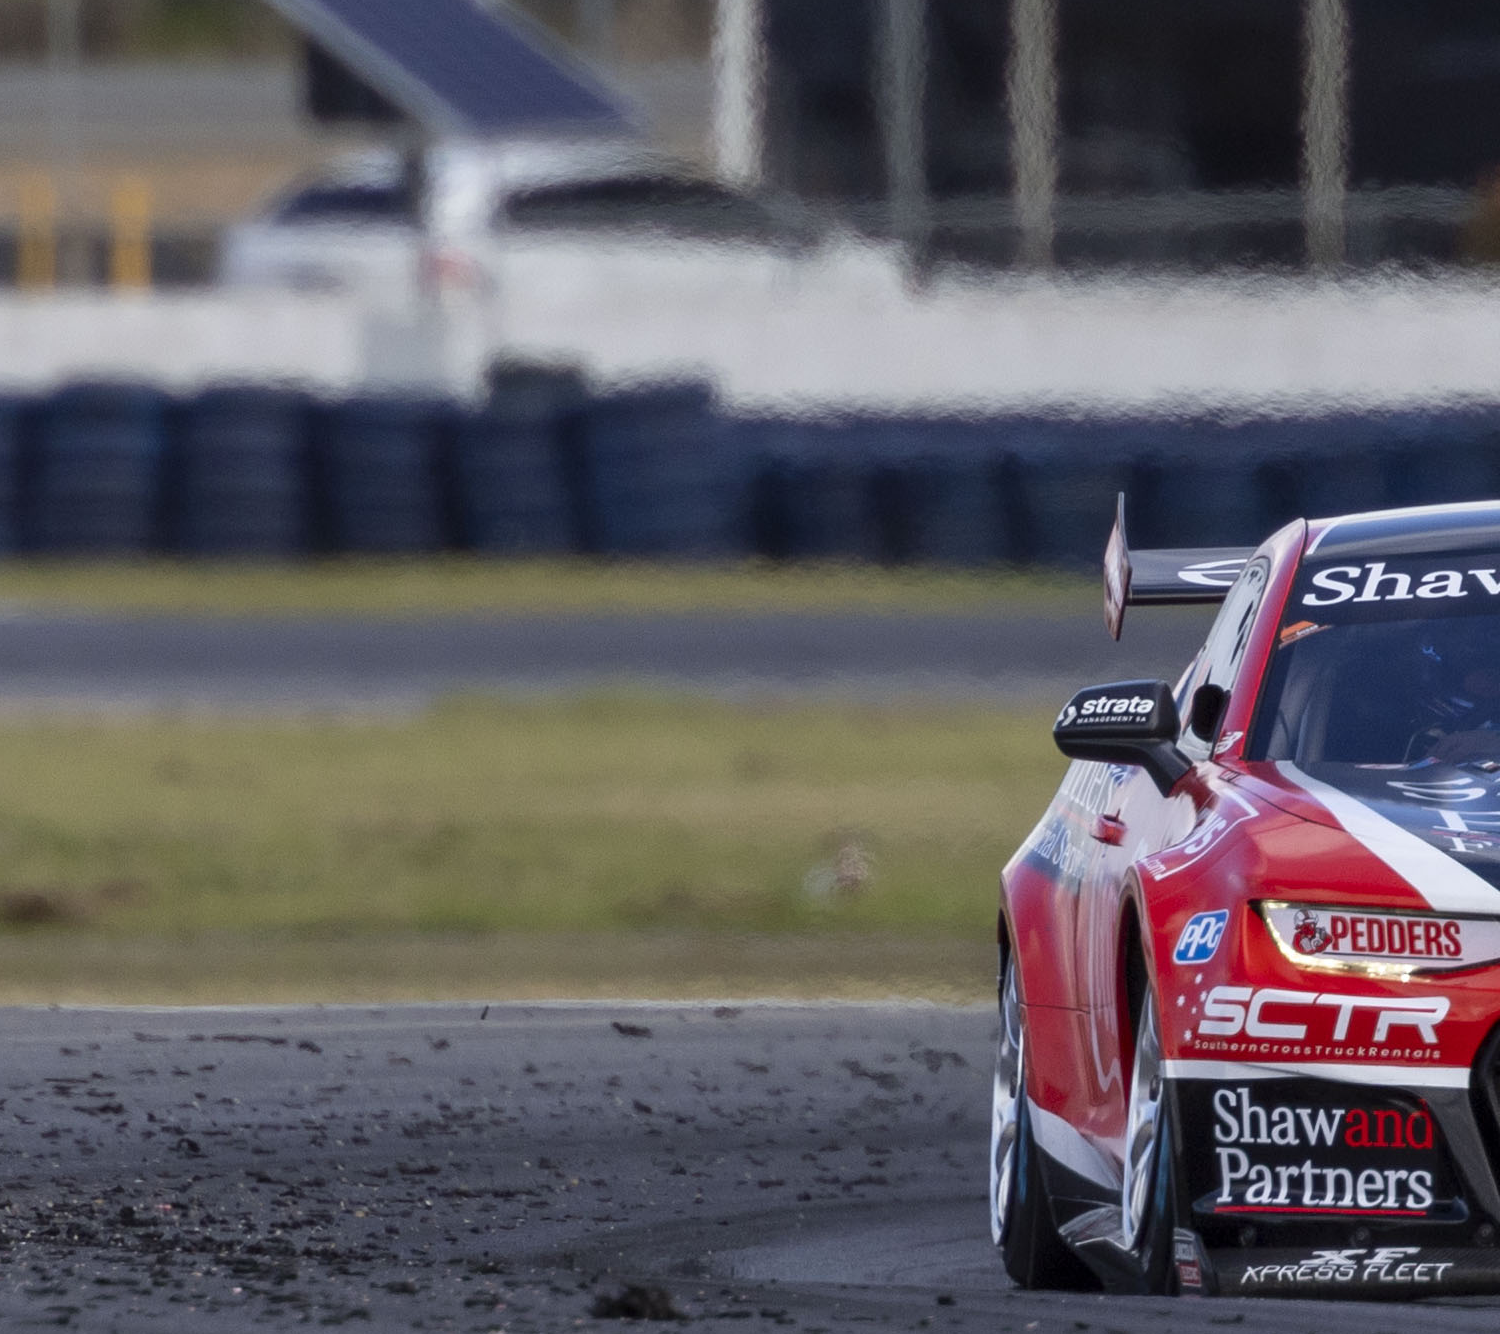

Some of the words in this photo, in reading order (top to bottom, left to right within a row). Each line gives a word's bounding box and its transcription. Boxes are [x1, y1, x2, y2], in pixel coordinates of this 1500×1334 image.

[1076, 715, 1133, 724] MANAGEMENT
[1080, 695, 1155, 715] strata
[1180, 917, 1225, 958] PPG
[1330, 914, 1463, 957] PEDDERS
[1198, 986, 1451, 1044] SCTR
[1215, 1146, 1434, 1209] Partners
[1300, 1246, 1421, 1265] XF
[1240, 1263, 1357, 1284] XPRESS
[1362, 1262, 1454, 1282] FLEET
